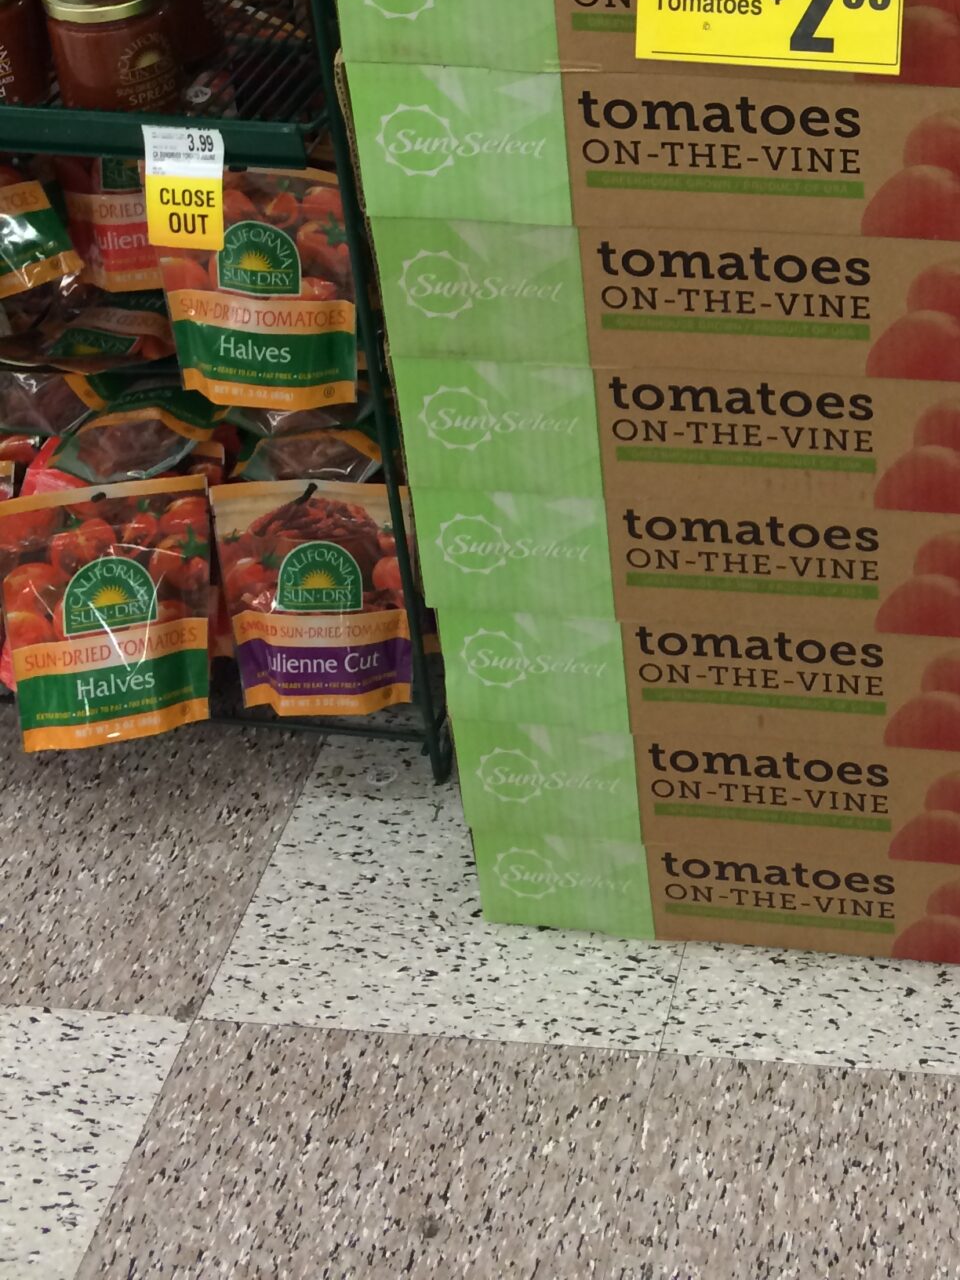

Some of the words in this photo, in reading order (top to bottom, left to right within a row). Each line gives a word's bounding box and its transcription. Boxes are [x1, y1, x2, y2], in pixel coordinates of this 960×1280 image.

[577, 89, 861, 138] tomatoes
[187, 133, 214, 153] 3.99
[581, 138, 861, 175] ON-THE-VINE
[159, 187, 216, 208] CLOSE
[168, 211, 209, 235] OUT
[222, 227, 294, 269] CALIFORNIA
[597, 240, 871, 286] tomatoes
[180, 298, 251, 325] SUN-DRIED
[254, 309, 347, 328] TOMATOES
[601, 285, 871, 320] ON-THE-VINE
[218, 334, 292, 363] Halves
[608, 375, 874, 421] tomatoes
[611, 418, 873, 454] ON-THE-VINE
[622, 508, 880, 552] tomatoes
[283, 547, 356, 588] CALIFORNIA
[625, 546, 879, 581] ON-THE-VINE
[69, 562, 150, 610] CALIFORNIA
[24, 645, 112, 672] SUN-DRIED
[117, 626, 198, 657] TOMATOES
[280, 624, 343, 640] SUN-DRIED
[635, 625, 884, 668] tomatoes
[344, 651, 381, 673] Cut
[638, 663, 884, 697] ON-THE-VINE
[76, 670, 156, 701] Halves
[647, 742, 890, 788] tomatoes
[650, 778, 889, 814] ON-THE-VINE
[660, 851, 896, 896] tomatoes
[663, 883, 896, 919] ON-THE-VINE
